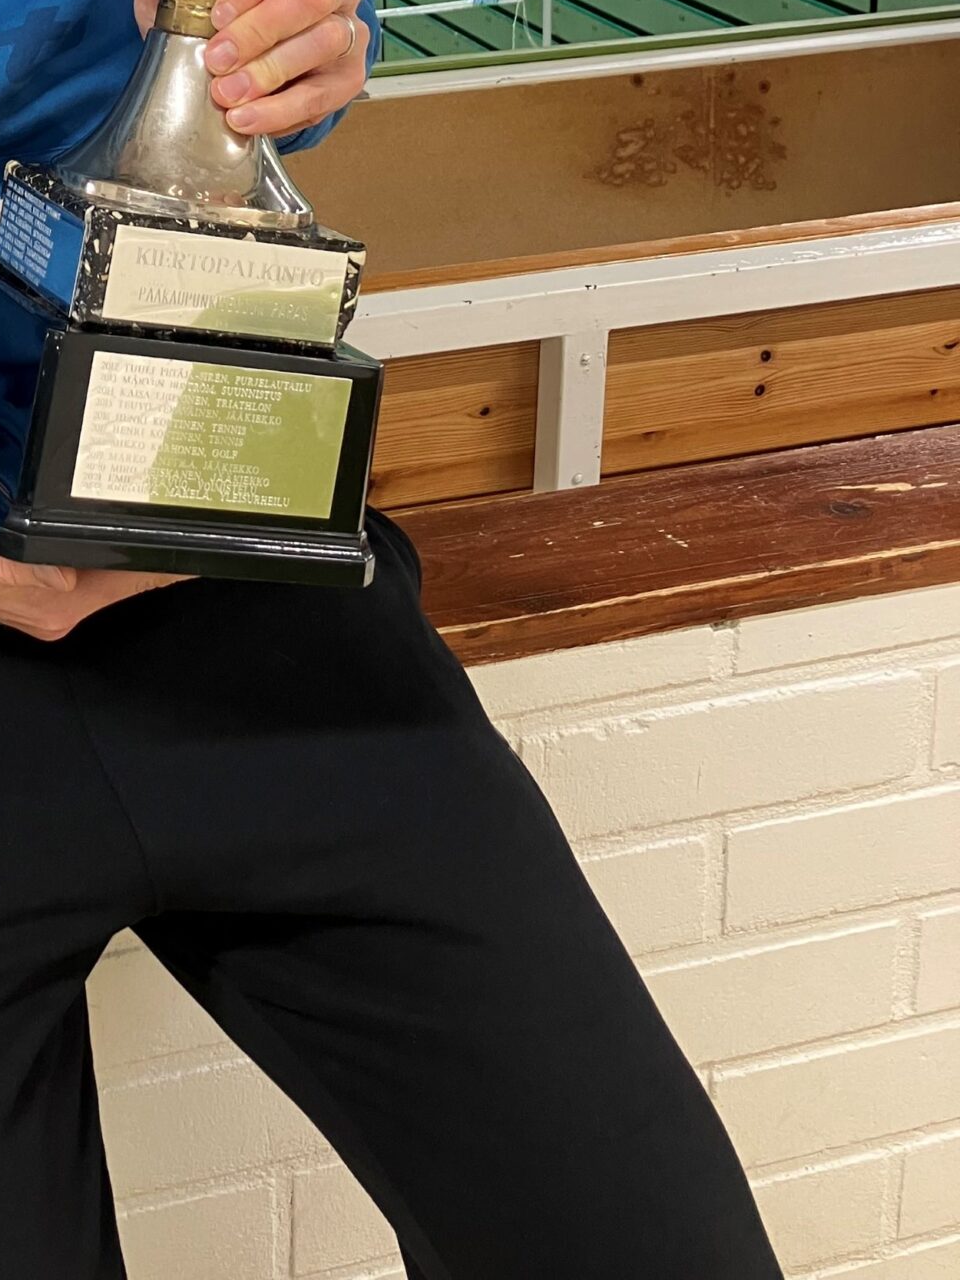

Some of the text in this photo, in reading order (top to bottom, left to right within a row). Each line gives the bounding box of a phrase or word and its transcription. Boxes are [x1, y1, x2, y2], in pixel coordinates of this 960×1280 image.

[136, 246, 326, 287] KIERTOPALKINTO
[234, 375, 312, 393] PURJELAUTAILU
[220, 386, 282, 401] SUUNNISTUS
[214, 398, 272, 413] TRIATHLON
[210, 423, 247, 435] TENNIS
[207, 434, 244, 447] TENNIS
[210, 448, 238, 460] GOLF
